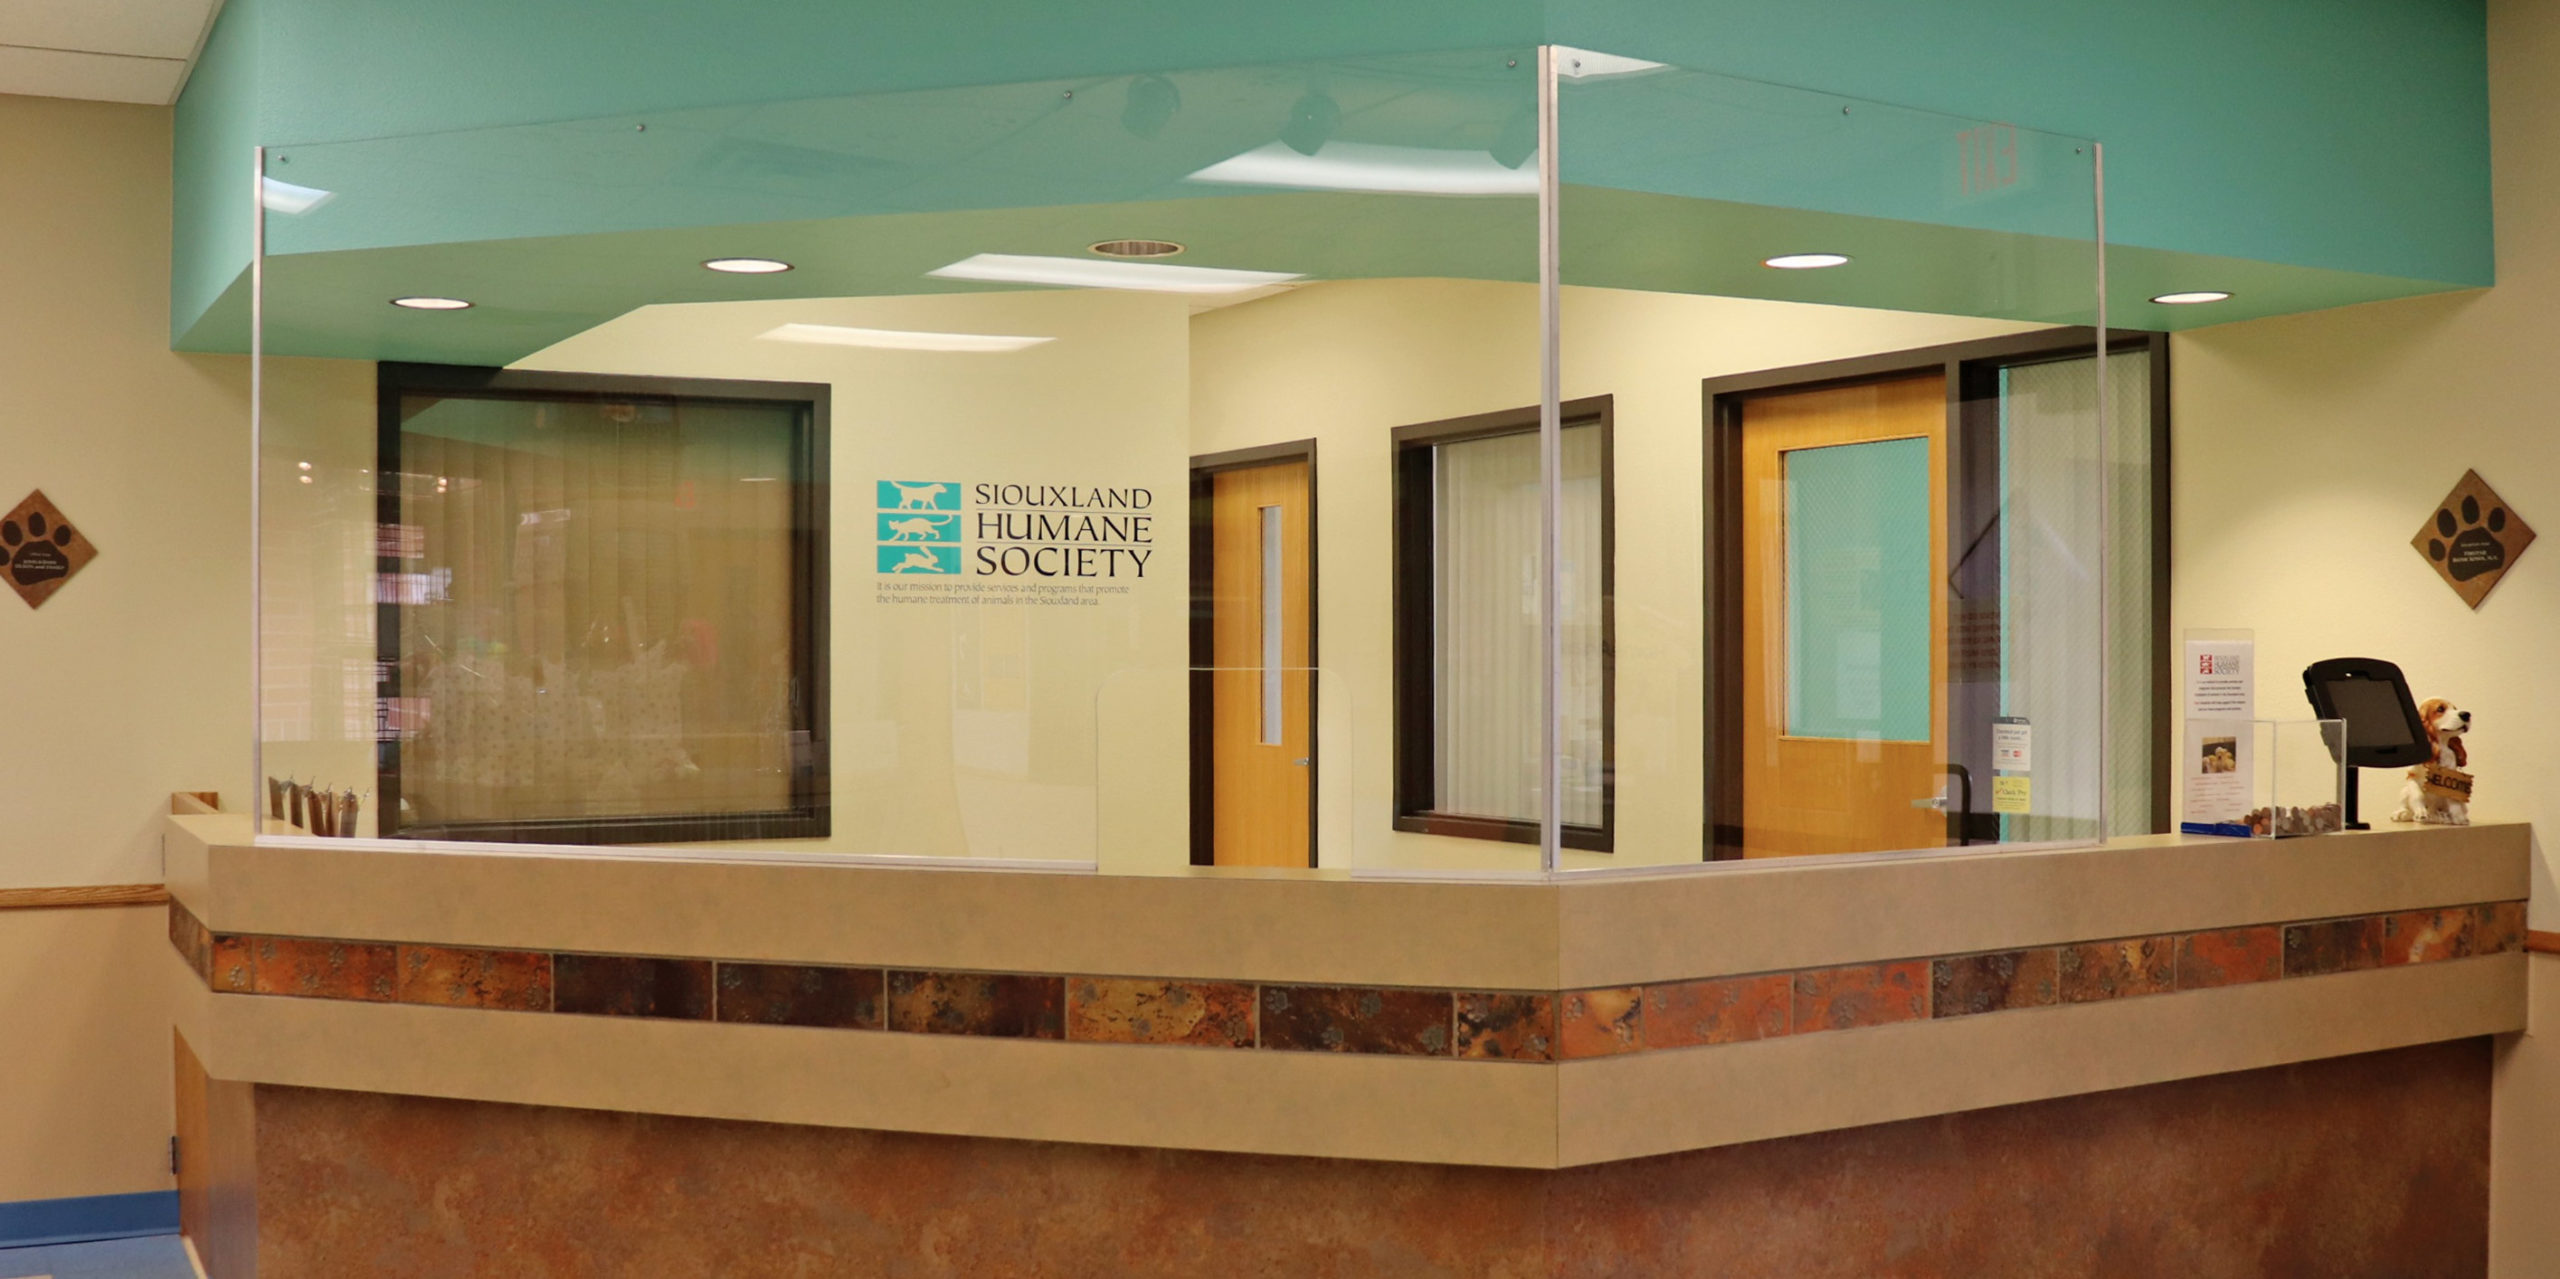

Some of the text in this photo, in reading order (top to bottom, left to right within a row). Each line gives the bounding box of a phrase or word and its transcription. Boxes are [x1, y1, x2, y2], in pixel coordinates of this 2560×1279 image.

[975, 483, 1153, 510] SIOUXLAND
[976, 512, 1153, 543] HUMANE
[975, 546, 1153, 578] SOCIETY
[876, 594, 892, 604] the
[892, 594, 928, 604] humane
[929, 595, 970, 605] treatment
[971, 594, 981, 605] of
[981, 595, 1015, 606] animals
[1016, 596, 1024, 605] in
[1024, 596, 1039, 606] the
[1039, 596, 1080, 607] Siouxland
[884, 582, 892, 592] is
[892, 583, 909, 592] our
[910, 582, 942, 592] mission
[944, 583, 952, 592] to
[954, 583, 985, 595] provide
[987, 583, 1019, 593] services
[1020, 583, 1037, 593] and
[1038, 585, 1077, 596] programs
[1079, 584, 1094, 594] that
[1096, 586, 1130, 597] promote
